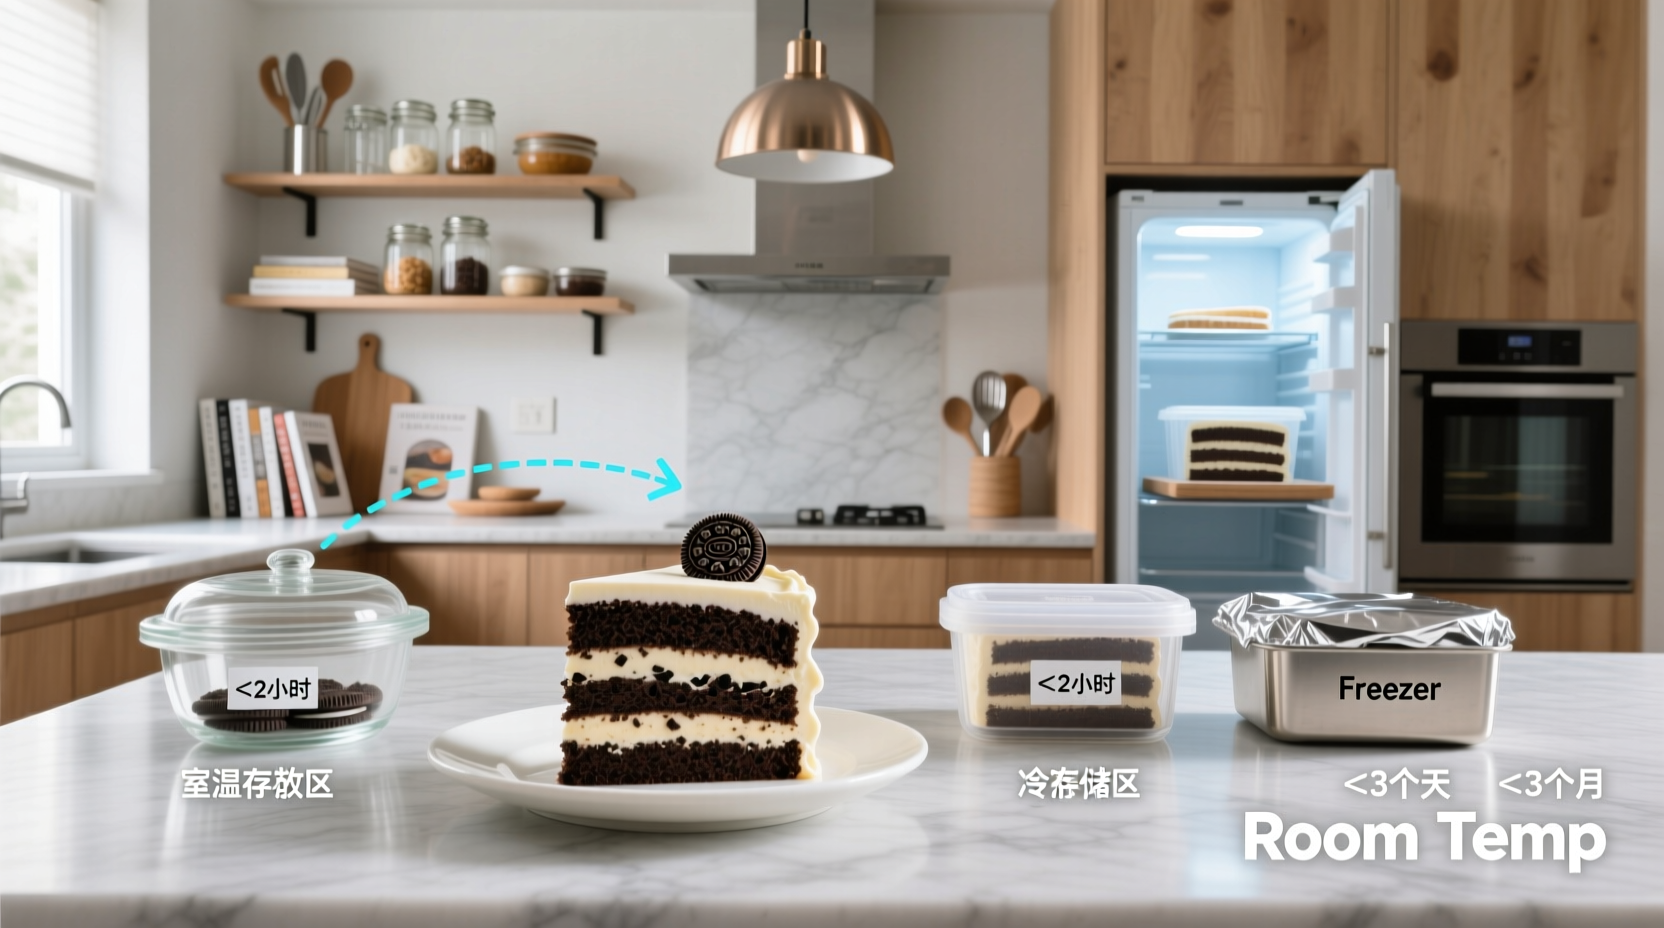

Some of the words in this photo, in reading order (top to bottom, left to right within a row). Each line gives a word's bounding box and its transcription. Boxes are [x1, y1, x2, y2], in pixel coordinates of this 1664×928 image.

[235, 677, 312, 700] <2小时
[1038, 672, 1116, 695] <2小时
[1339, 675, 1442, 701] Freezer
